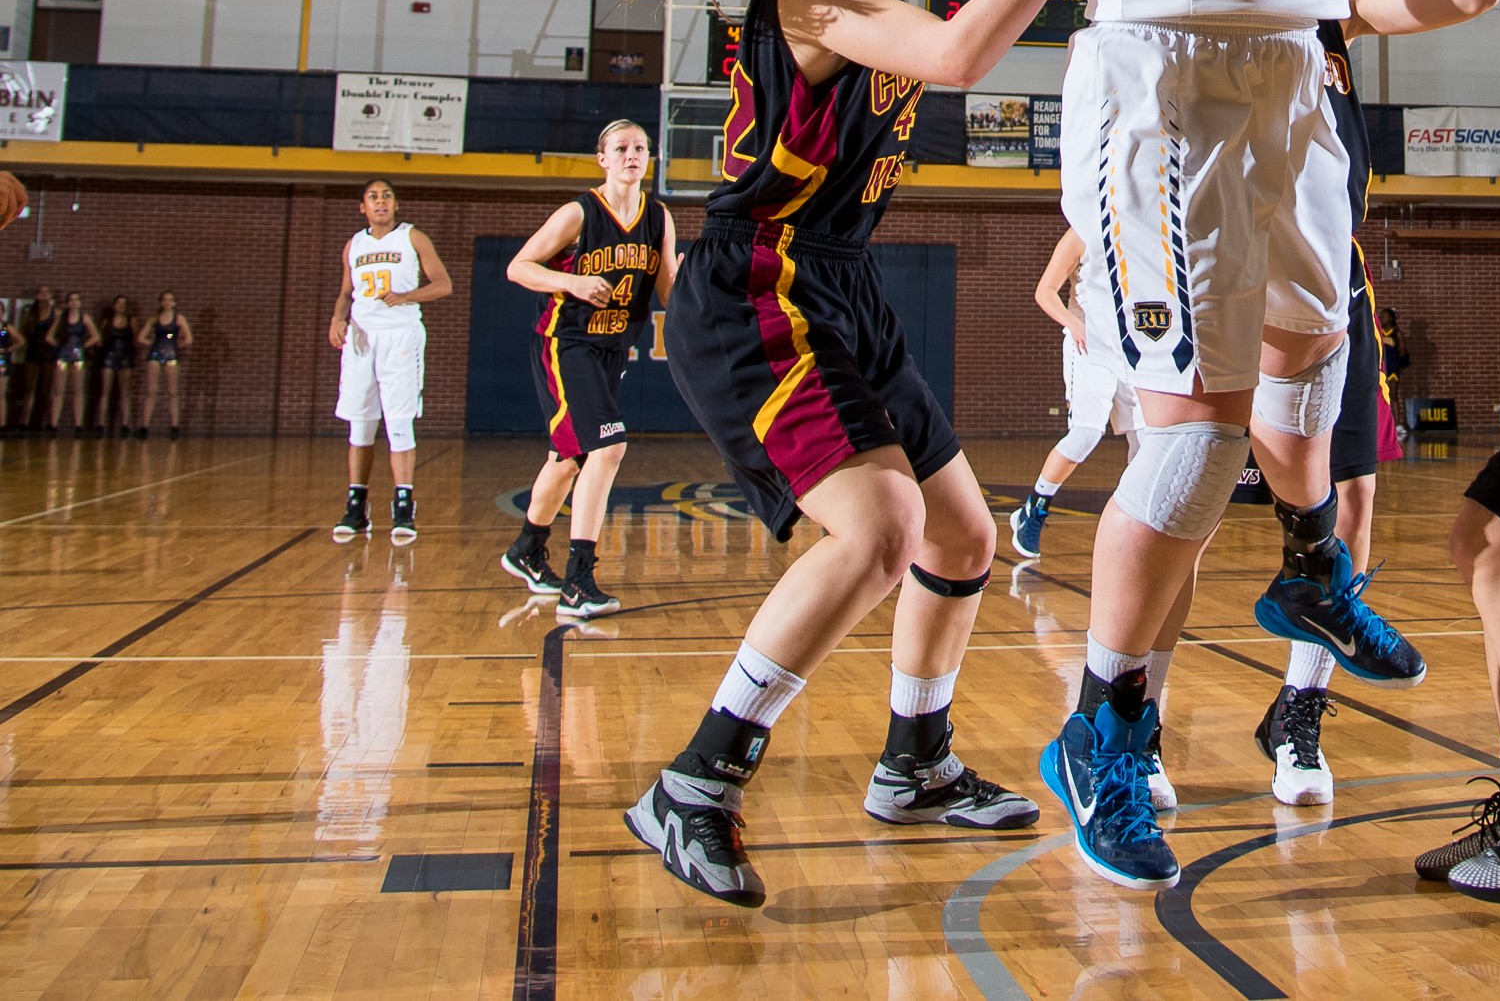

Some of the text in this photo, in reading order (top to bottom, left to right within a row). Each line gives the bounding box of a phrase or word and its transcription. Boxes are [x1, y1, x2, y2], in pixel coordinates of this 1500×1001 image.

[368, 77, 435, 88] The Denver
[0, 90, 54, 108] BLIN
[341, 89, 462, 103] DoubleTree Complex
[1034, 101, 1062, 112] READYI
[1034, 113, 1060, 124] RANGE
[1034, 125, 1049, 136] FOR
[1408, 145, 1425, 153] More
[355, 251, 402, 268] REGIS
[361, 269, 391, 297] 33
[587, 309, 630, 334] MES
[1136, 311, 1171, 327] RU
[1420, 408, 1448, 421] BLUE
[1237, 468, 1260, 485] VS
